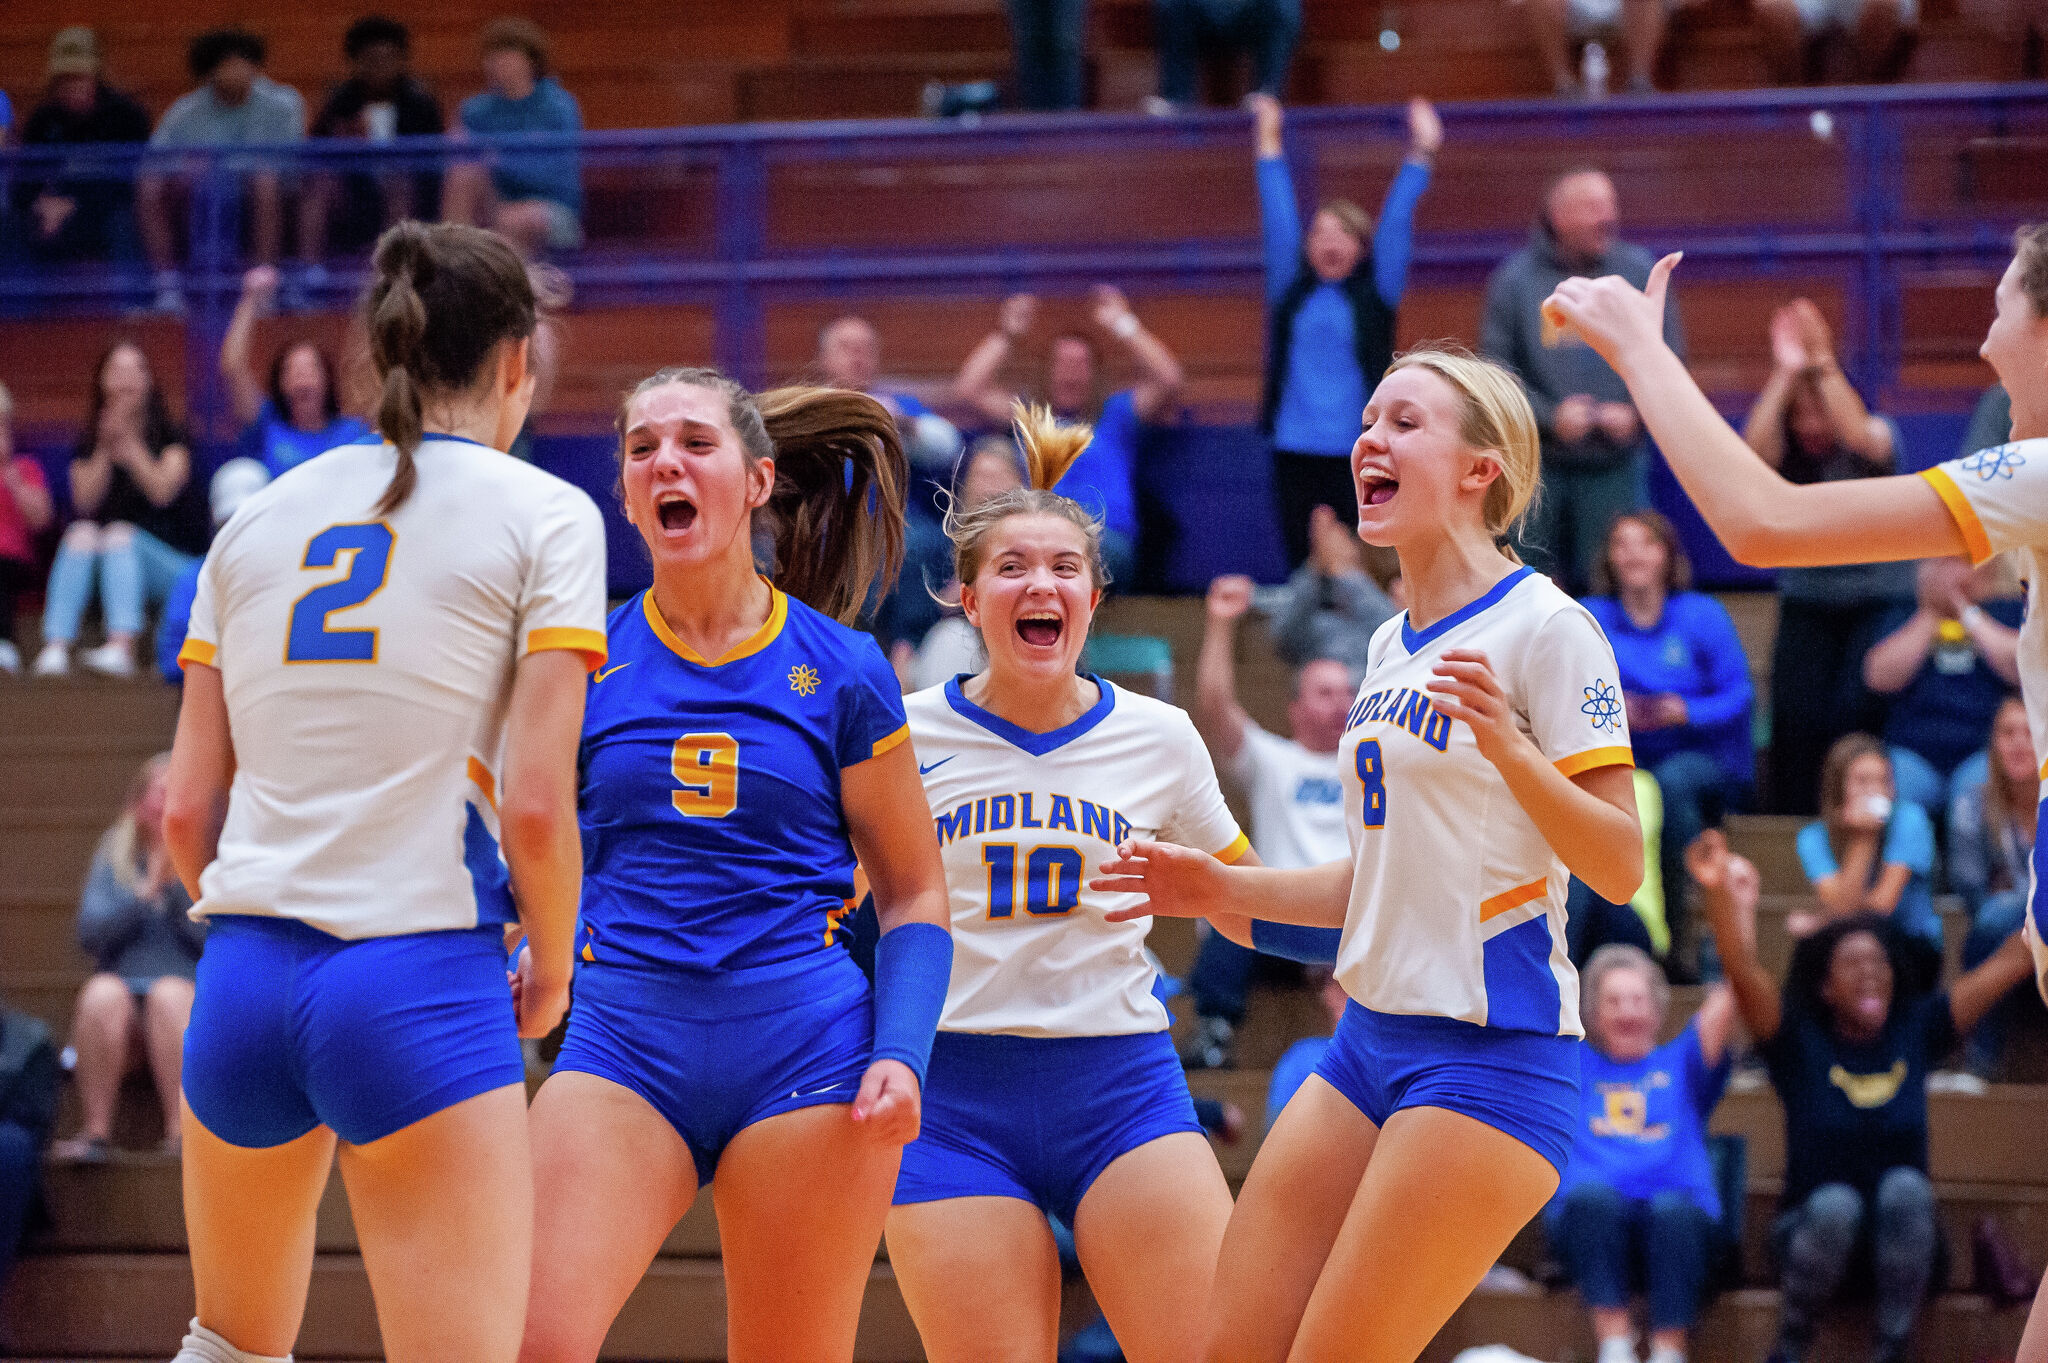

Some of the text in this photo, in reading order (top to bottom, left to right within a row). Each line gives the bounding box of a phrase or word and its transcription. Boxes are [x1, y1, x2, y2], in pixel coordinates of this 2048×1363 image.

[283, 520, 398, 665] 2
[671, 732, 739, 818] 9
[1354, 736, 1386, 830] 8
[981, 842, 1085, 921] 10
